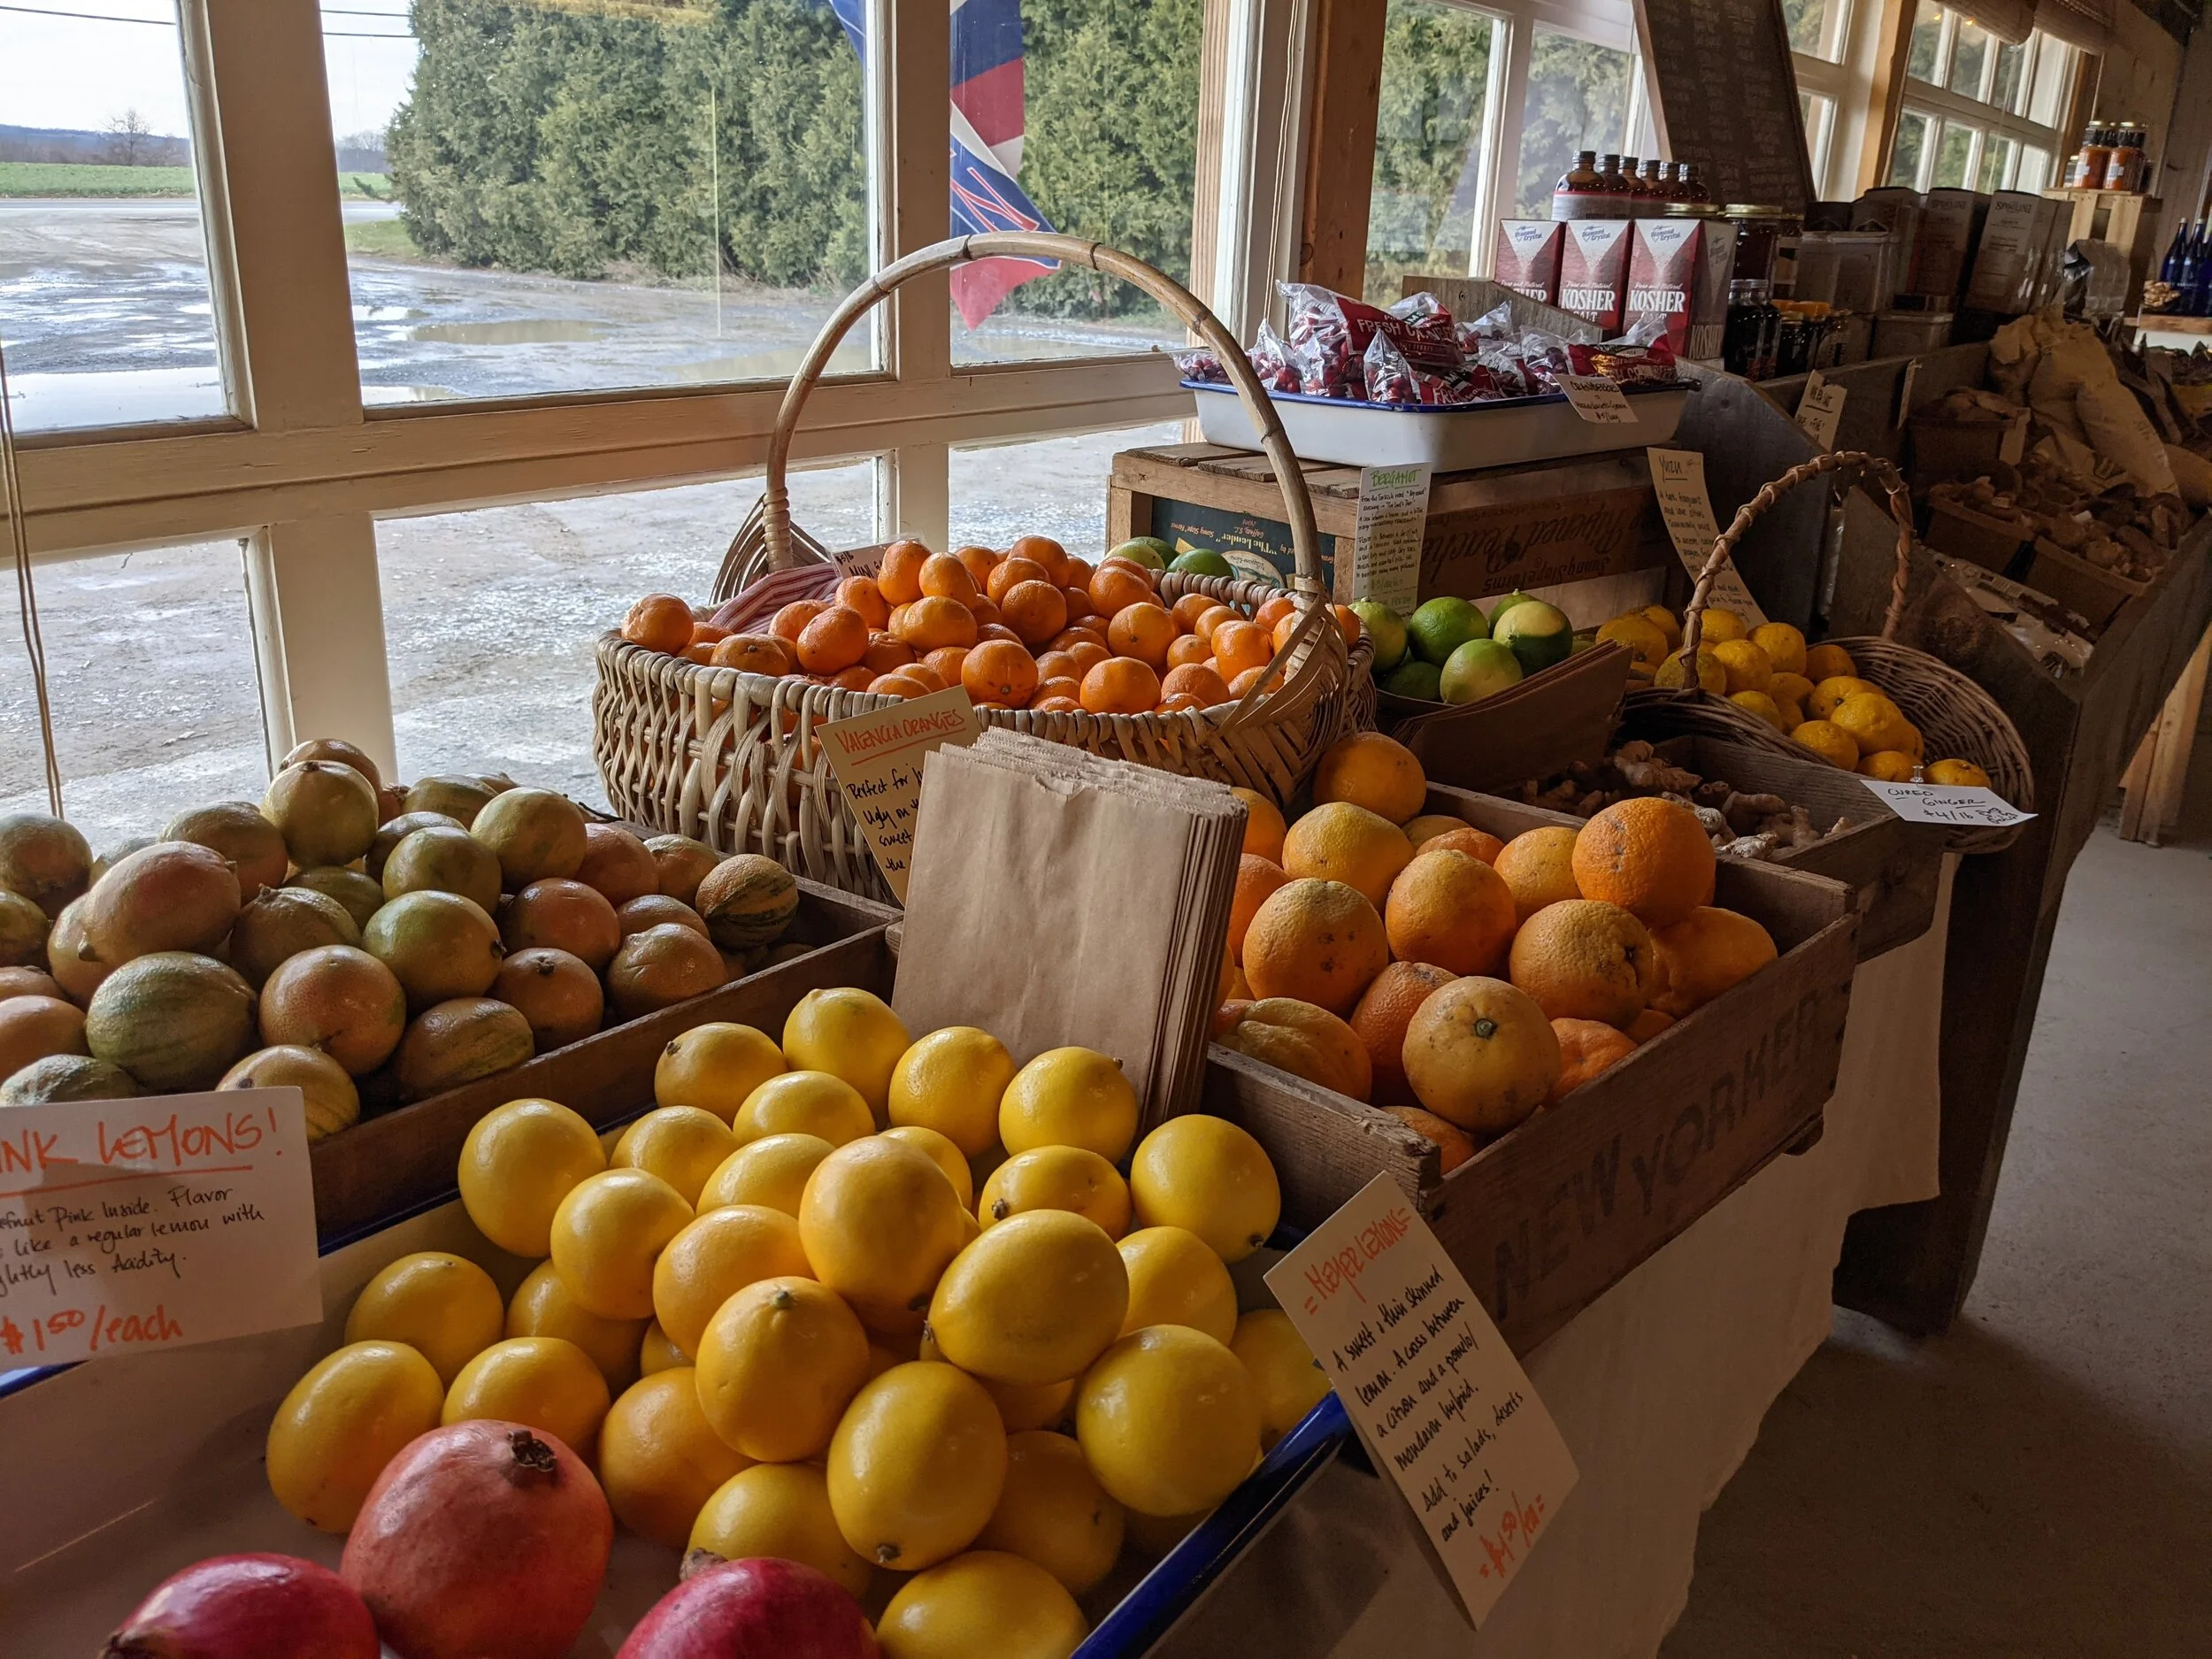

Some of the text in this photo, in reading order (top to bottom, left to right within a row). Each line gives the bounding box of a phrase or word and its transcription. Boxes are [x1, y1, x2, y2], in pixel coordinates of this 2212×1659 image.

[1561, 289, 1616, 311] KOSHER
[1629, 290, 1686, 312] KOSHER
[1357, 319, 1402, 335] FRESH
[1370, 469, 1422, 488] BERGAMOT
[834, 709, 964, 754] VALENCIA ORANGES
[846, 778, 887, 800] Perfect
[893, 768, 909, 790] for
[1922, 797, 1986, 807] GINGER
[863, 804, 897, 830] Ugly
[0, 1107, 282, 1173] NK LEMONS!
[1494, 987, 1821, 1321] NEW YORKER
[47, 1206, 95, 1232] Pink
[168, 1185, 234, 1207] Flavor
[14, 1203, 265, 1256] like a regular lemon with
[64, 1259, 96, 1279] less
[1333, 1349, 1348, 1372] A
[1378, 1298, 1409, 1327] thin
[1405, 1263, 1445, 1309] skinned
[1393, 1349, 1407, 1369] A
[1403, 1333, 1428, 1361] cross
[1422, 1298, 1465, 1338] between
[1377, 1423, 1388, 1438] a
[1386, 1394, 1417, 1429] citron
[1417, 1368, 1440, 1395] and
[1438, 1363, 1447, 1377] a
[1421, 1477, 1448, 1512] Add
[1442, 1463, 1457, 1483] to
[1441, 1511, 1460, 1542] and
